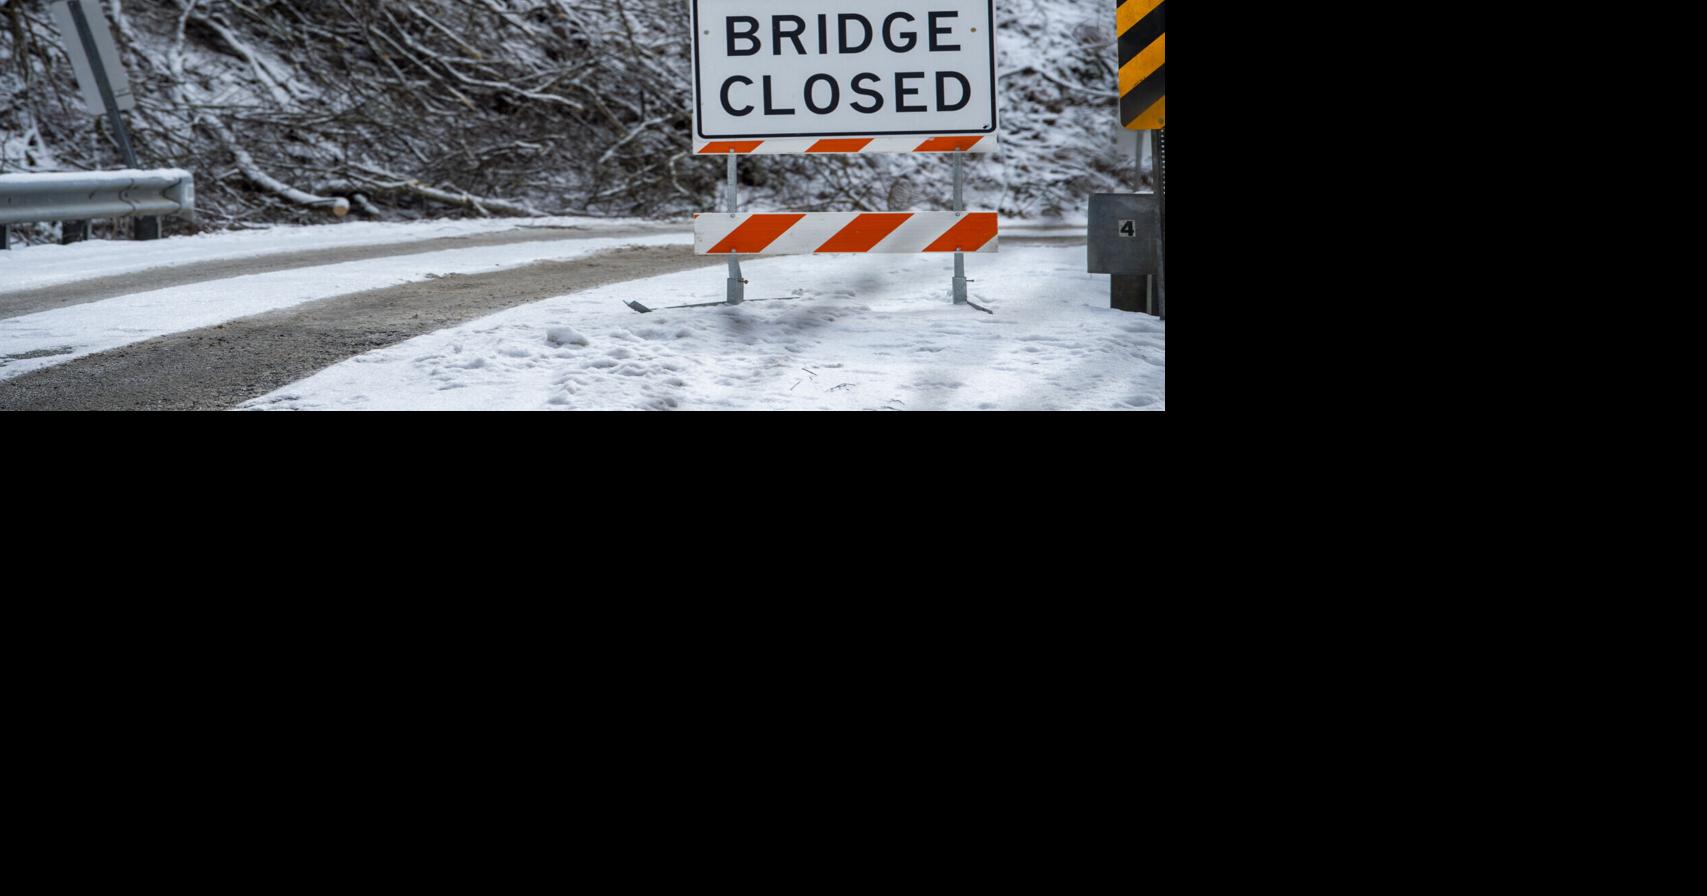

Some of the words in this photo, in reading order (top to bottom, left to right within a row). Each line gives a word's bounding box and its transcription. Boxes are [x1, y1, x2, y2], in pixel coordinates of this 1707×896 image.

[725, 10, 961, 56] BRIDGE
[719, 70, 971, 117] CLOSED
[1120, 221, 1135, 237] 4
